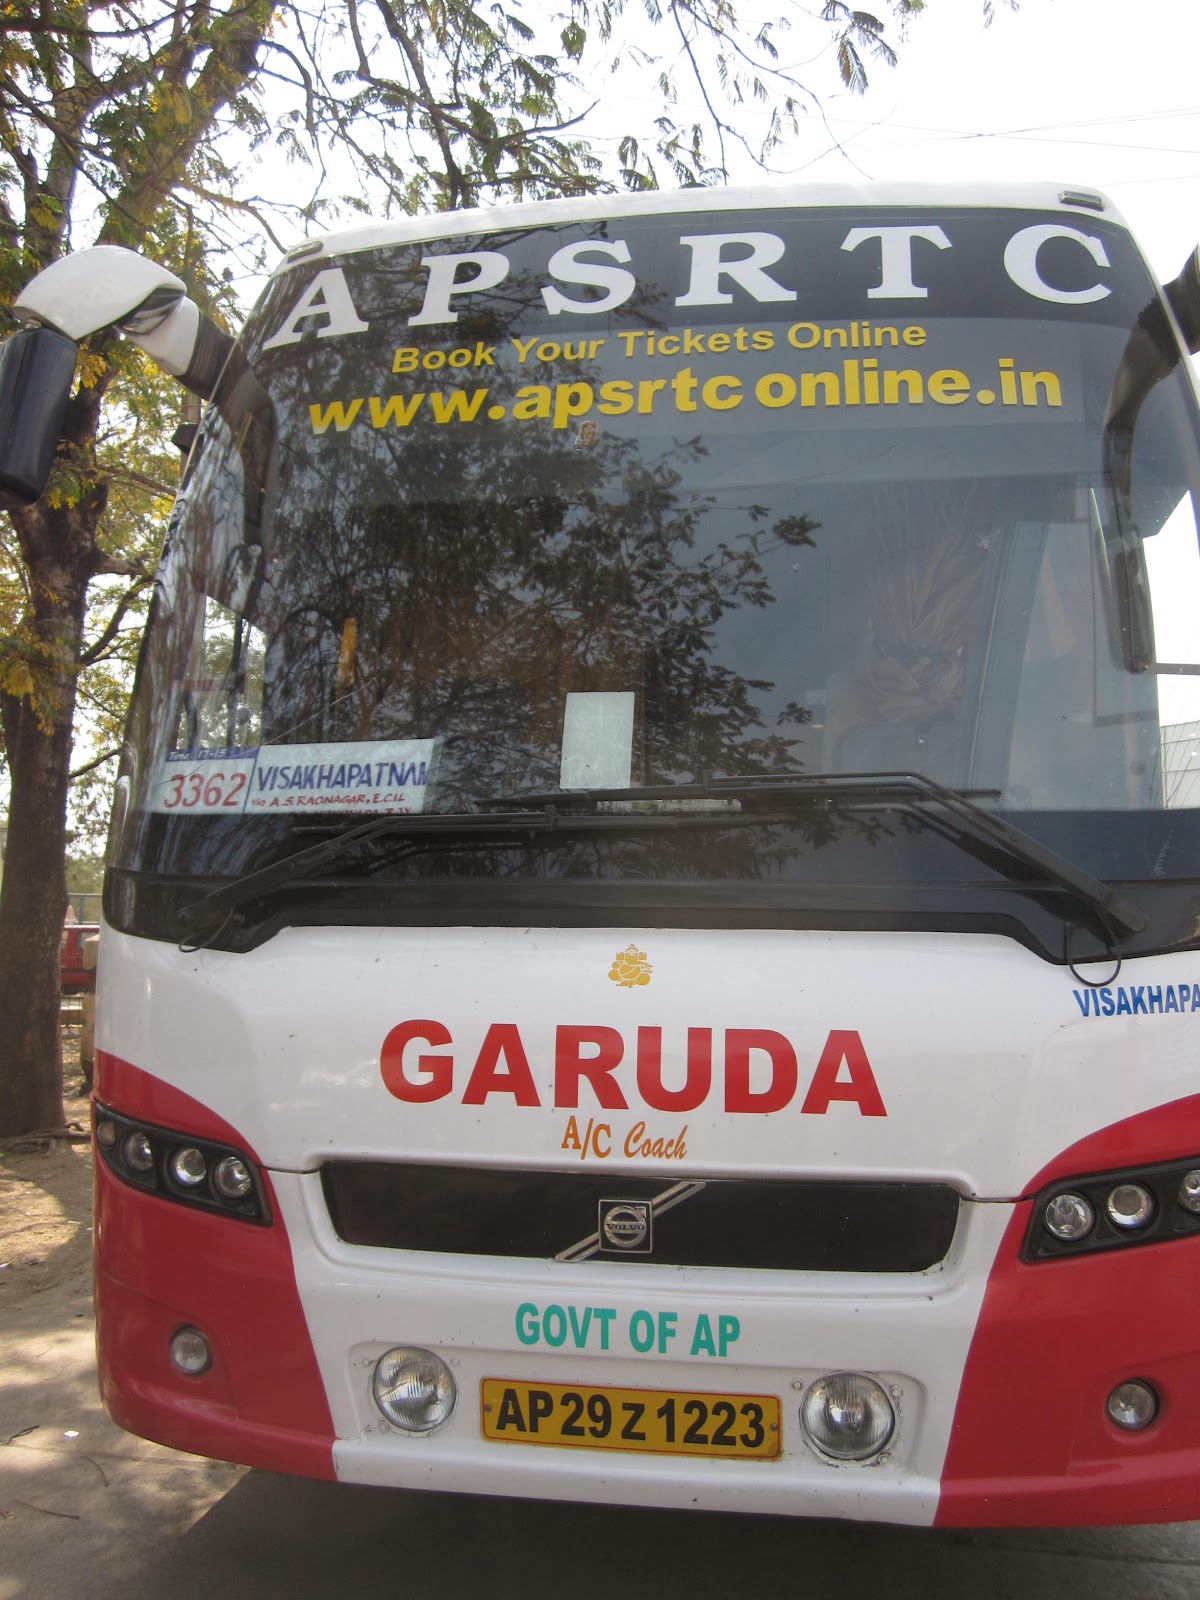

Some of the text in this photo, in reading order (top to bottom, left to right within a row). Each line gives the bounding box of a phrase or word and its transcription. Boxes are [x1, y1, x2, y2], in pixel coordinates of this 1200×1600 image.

[263, 224, 1112, 351] APSRTC
[391, 321, 928, 373] Book Your Tickets Online
[163, 771, 247, 808] 3362
[380, 1019, 888, 1118] GARUDA
[561, 1115, 688, 1160] A/C Coach
[606, 1223, 645, 1231] VOLVO
[515, 1302, 741, 1357] GOVT OF AP
